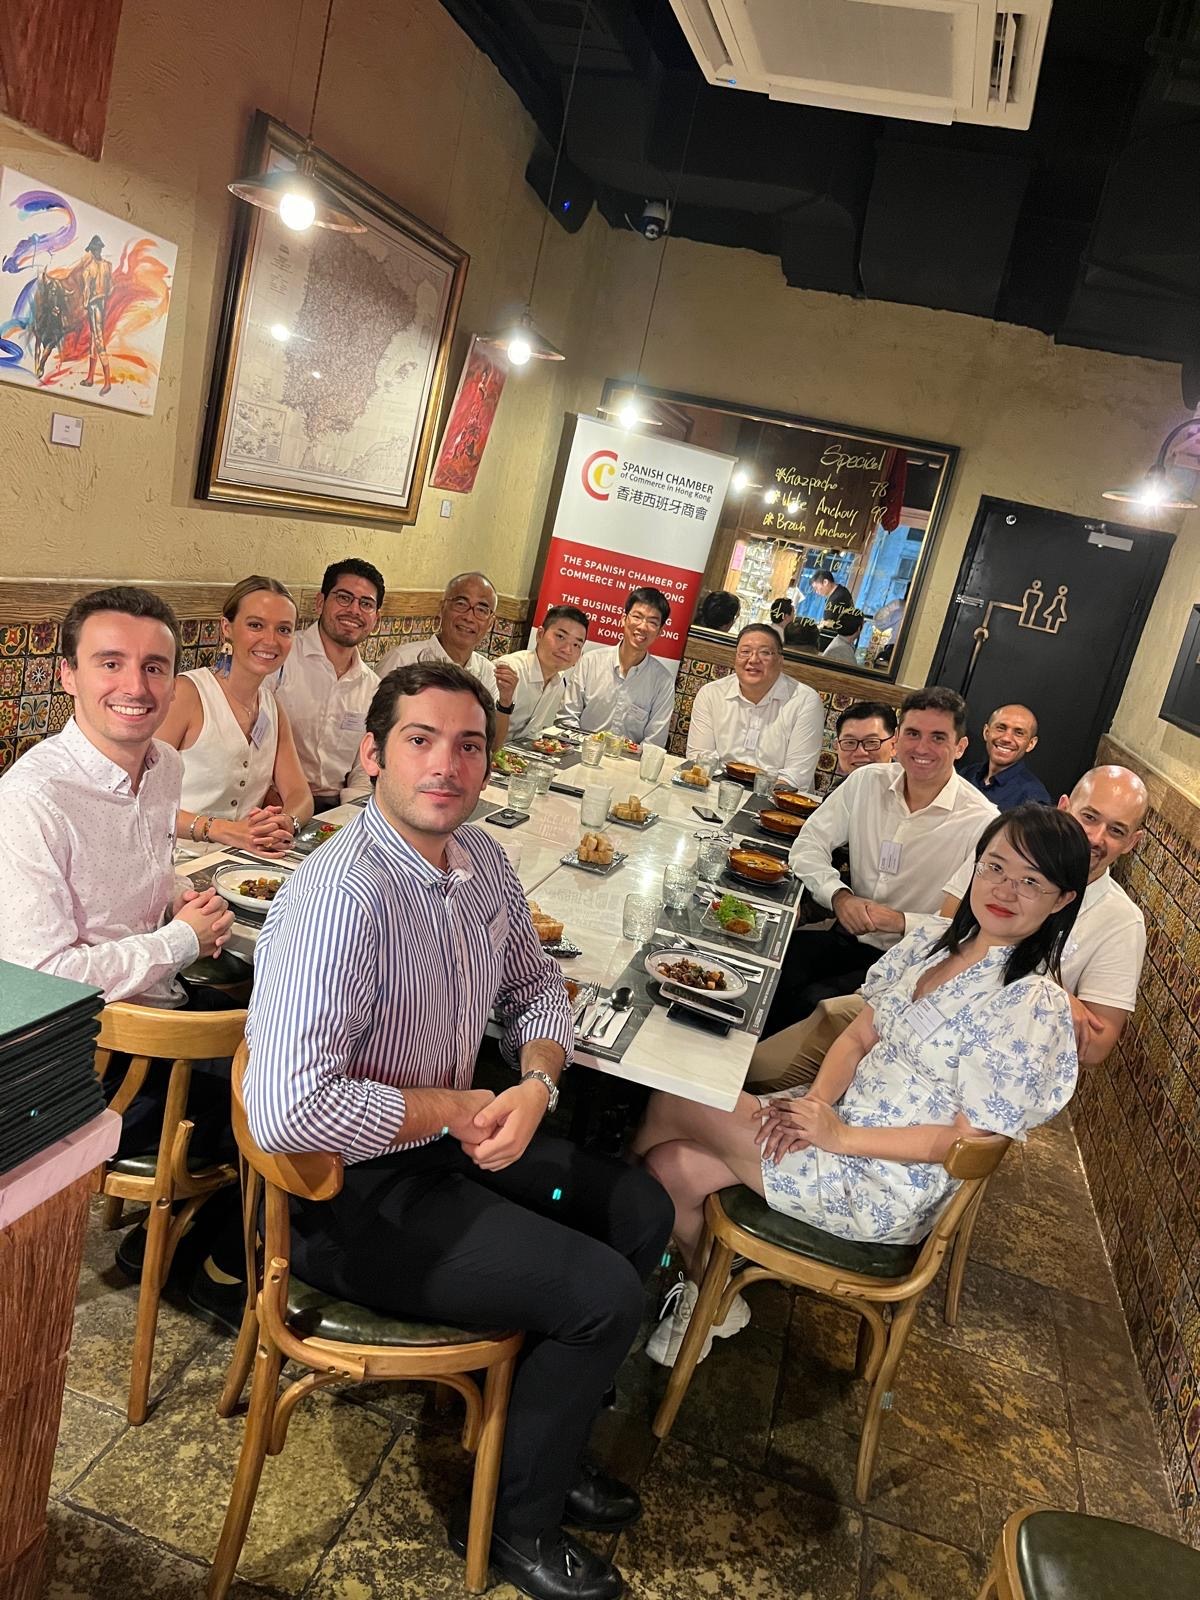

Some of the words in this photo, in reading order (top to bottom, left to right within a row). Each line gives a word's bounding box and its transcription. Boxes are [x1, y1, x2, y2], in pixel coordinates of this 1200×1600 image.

[820, 444, 886, 474] Special
[620, 472, 629, 480] of
[629, 472, 666, 490] Commerce
[666, 483, 674, 491] in
[674, 486, 693, 499] Hong
[694, 492, 712, 503] Kong
[622, 461, 664, 480] SPANISH
[665, 473, 714, 495] CHAMBER
[869, 481, 890, 498] 78
[616, 485, 708, 522] 香港西班牙商會
[815, 496, 859, 527] Anchovy
[814, 519, 857, 547] Anchovy
[560, 567, 614, 587] COMMERCE
[615, 580, 627, 590] IN
[563, 554, 582, 566] THE
[584, 560, 626, 576] SPANISH
[628, 570, 673, 588] CHAMBER
[675, 582, 689, 591] OF
[561, 593, 580, 605] THE
[597, 628, 624, 641] KONG
